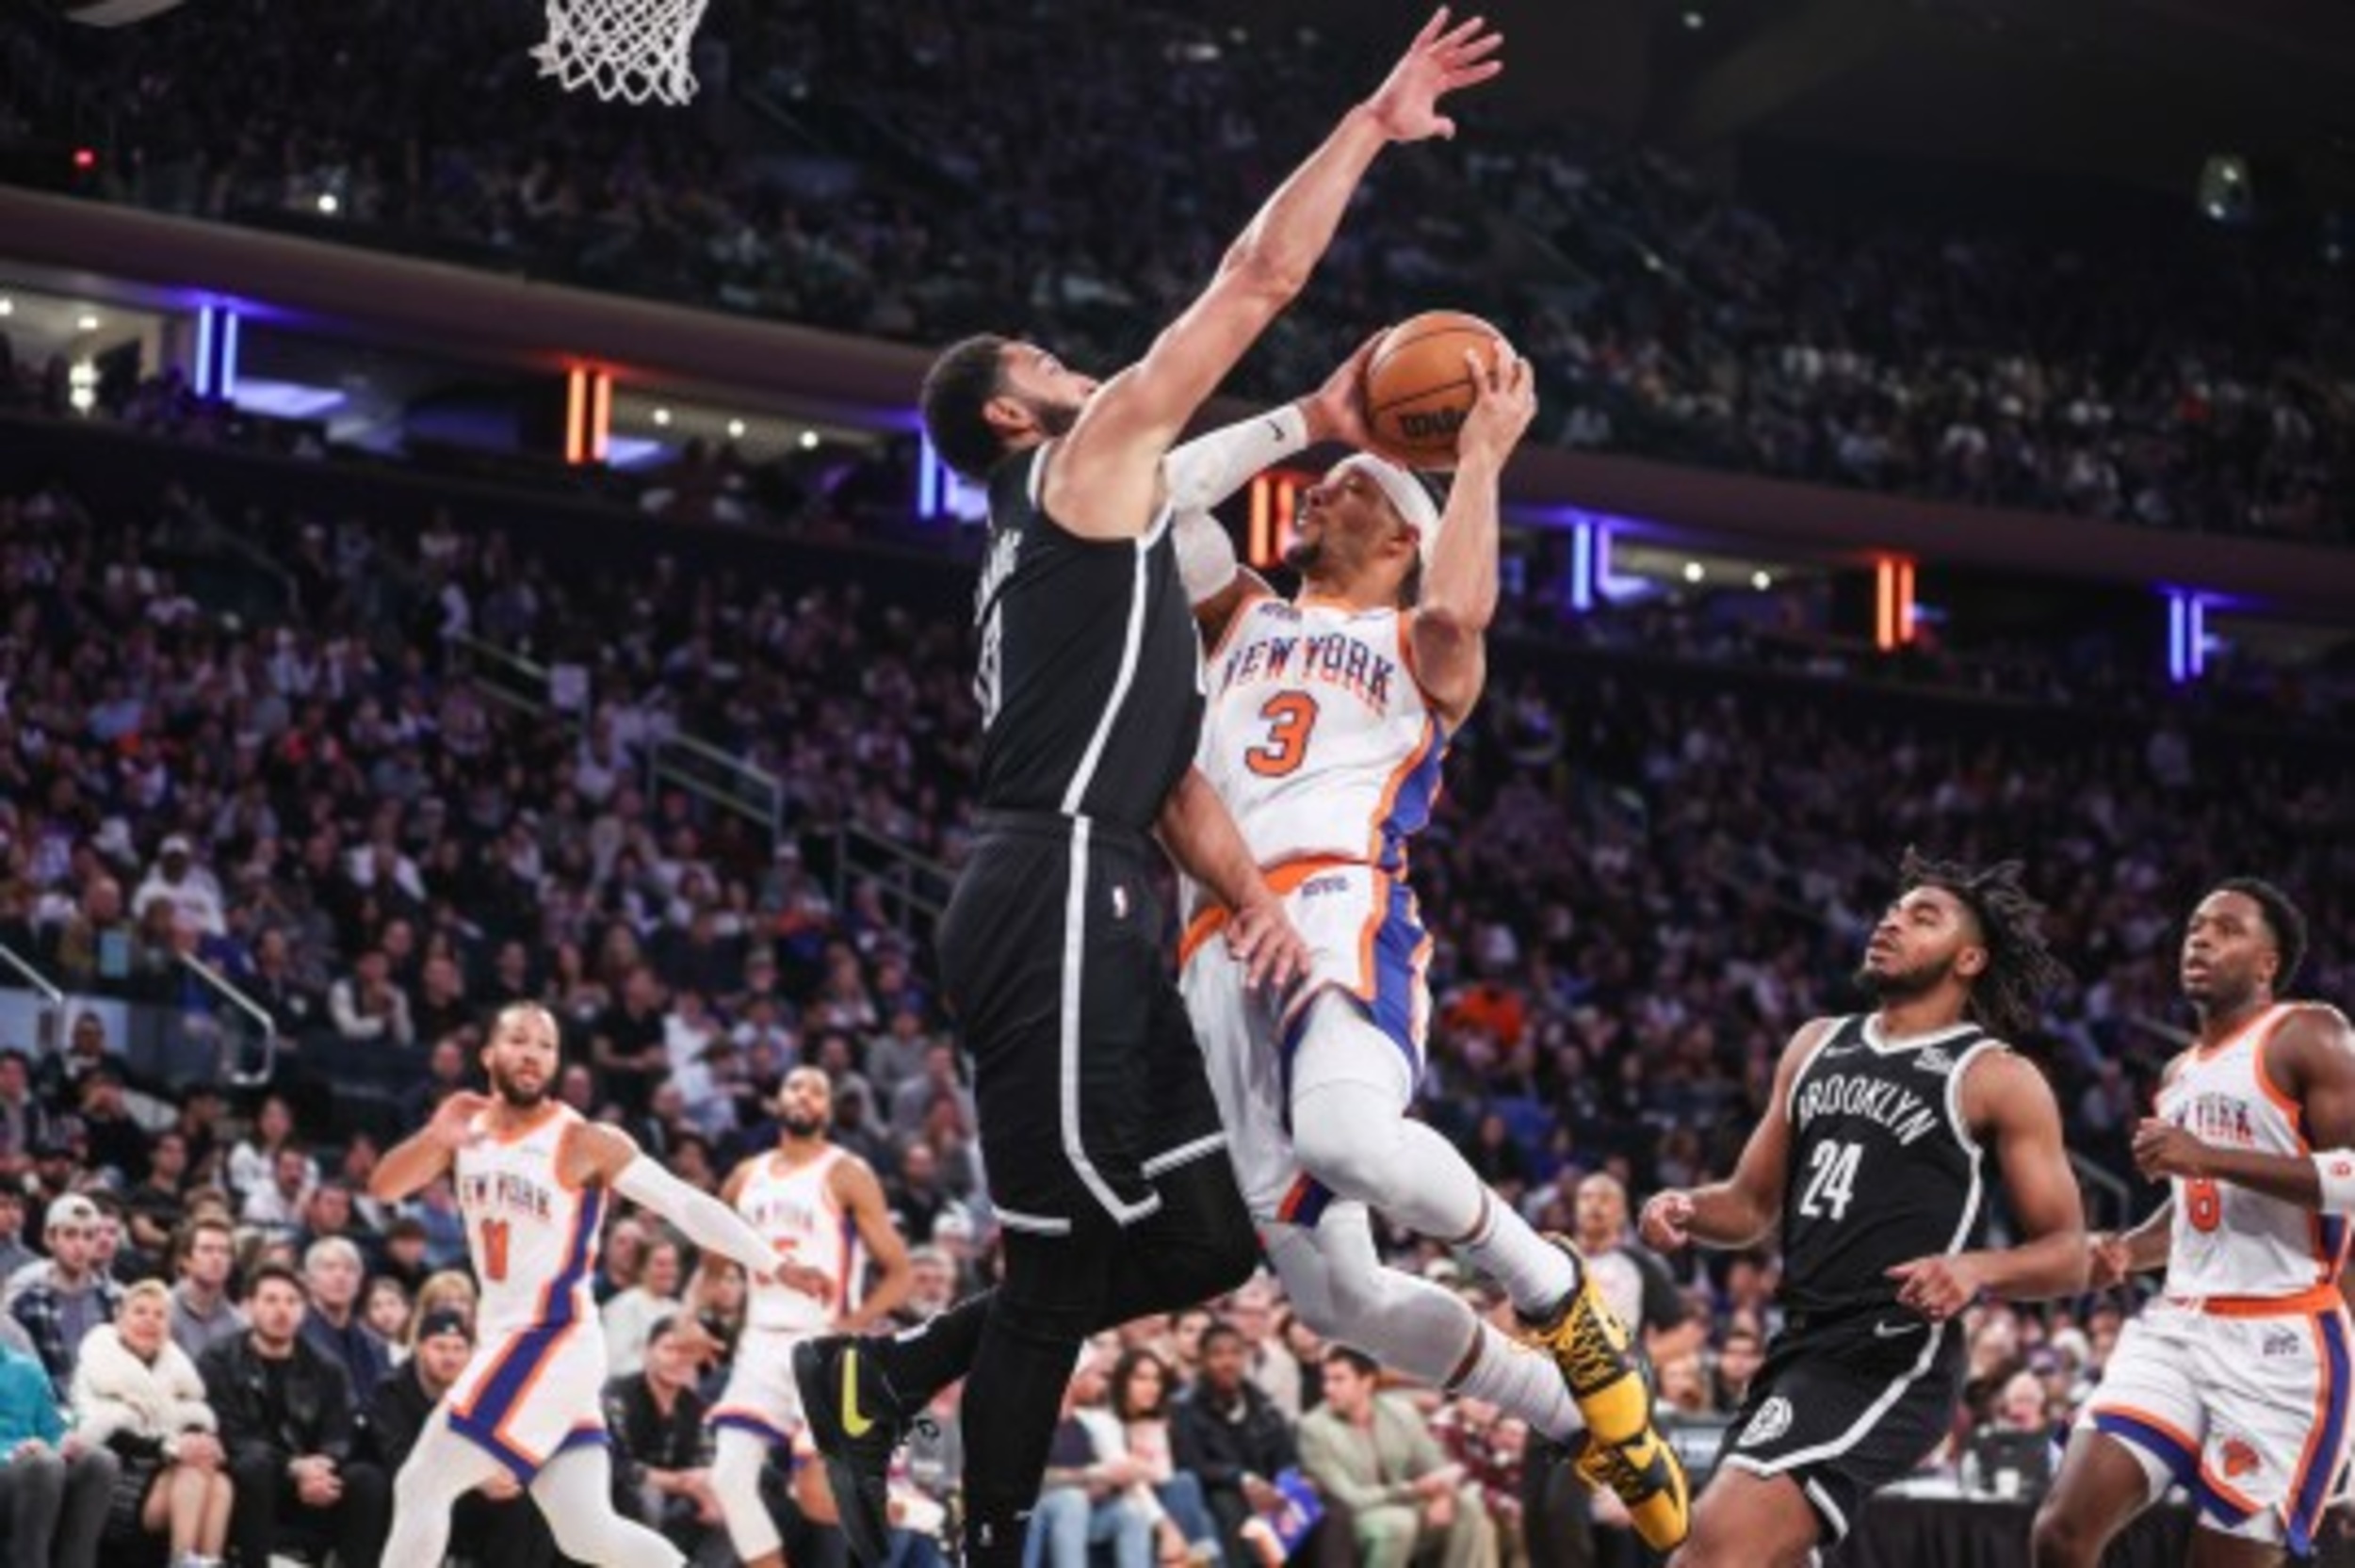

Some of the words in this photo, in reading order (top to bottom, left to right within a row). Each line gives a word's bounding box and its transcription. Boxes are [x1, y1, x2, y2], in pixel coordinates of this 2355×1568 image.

[1301, 632, 1395, 719] YORK
[1244, 689, 1318, 778] 3
[1799, 1140, 1862, 1220] 24
